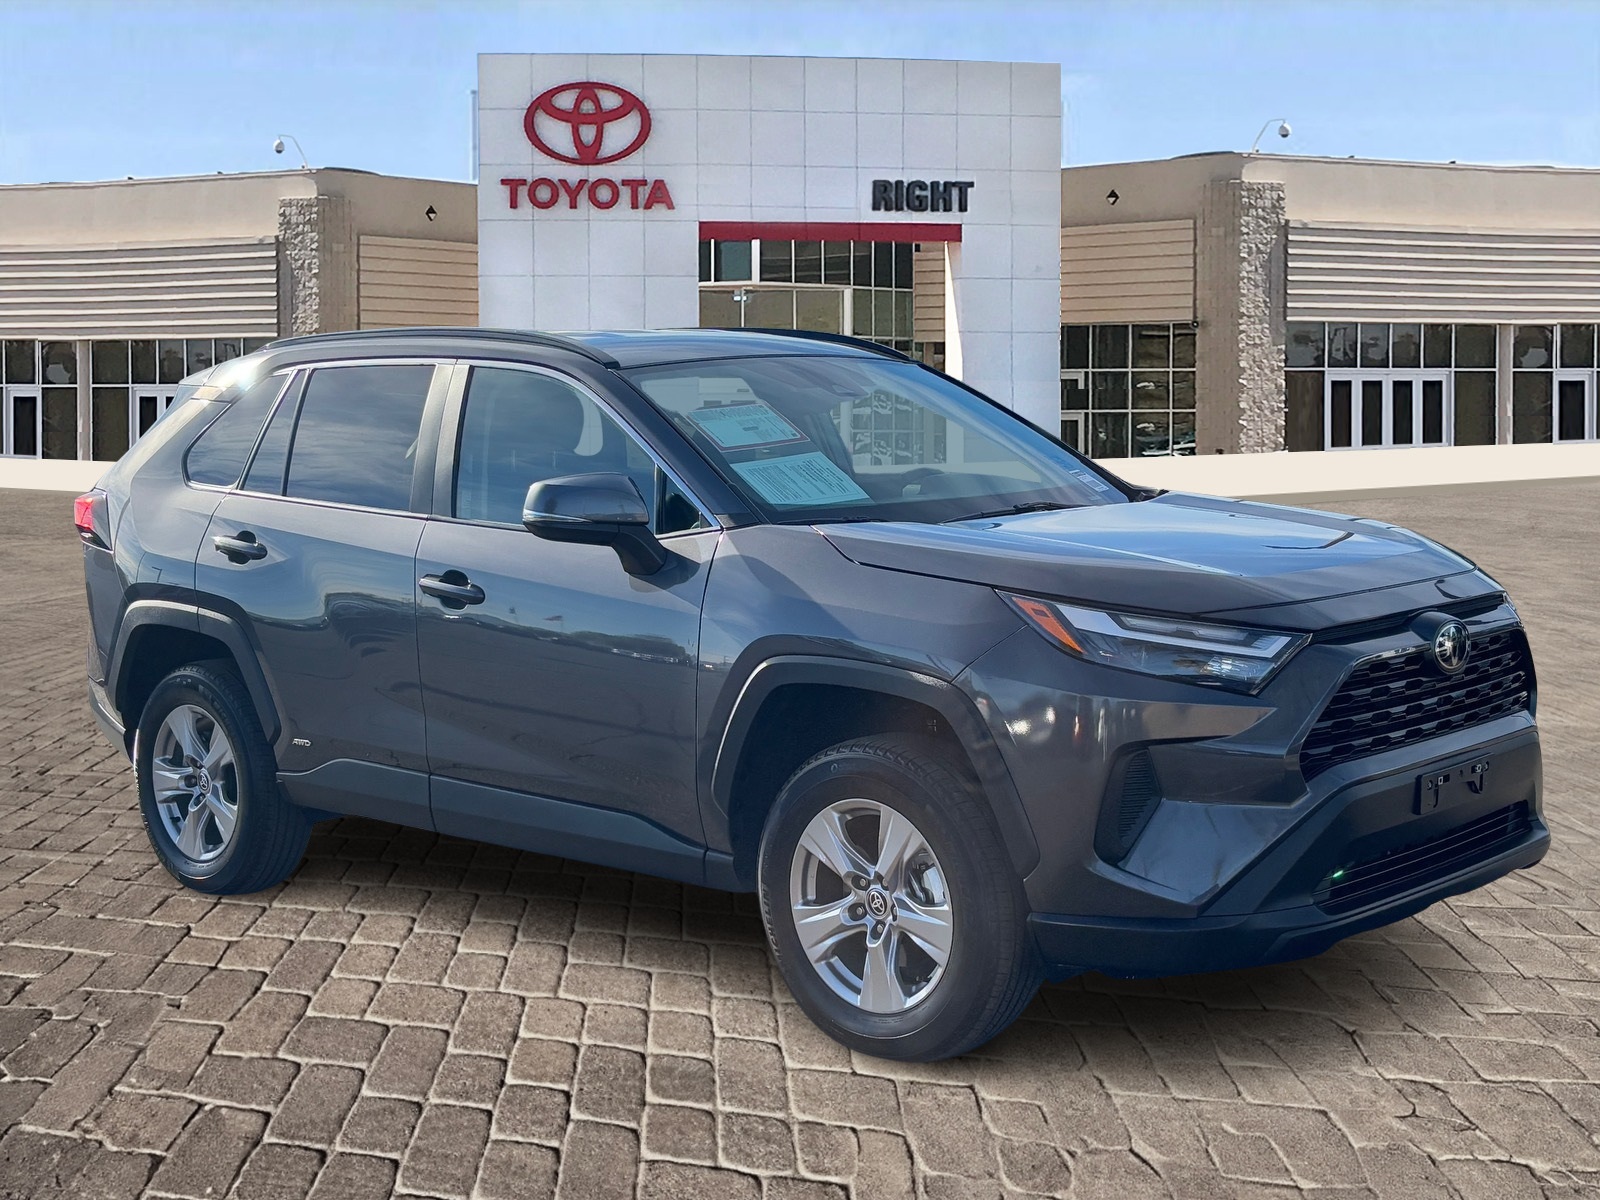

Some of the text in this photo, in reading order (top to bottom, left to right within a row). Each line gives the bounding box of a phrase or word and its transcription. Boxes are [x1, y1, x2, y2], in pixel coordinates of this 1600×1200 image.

[500, 177, 675, 210] TOYOTA
[872, 179, 975, 212] RIGHT
[292, 738, 312, 747] AWD
